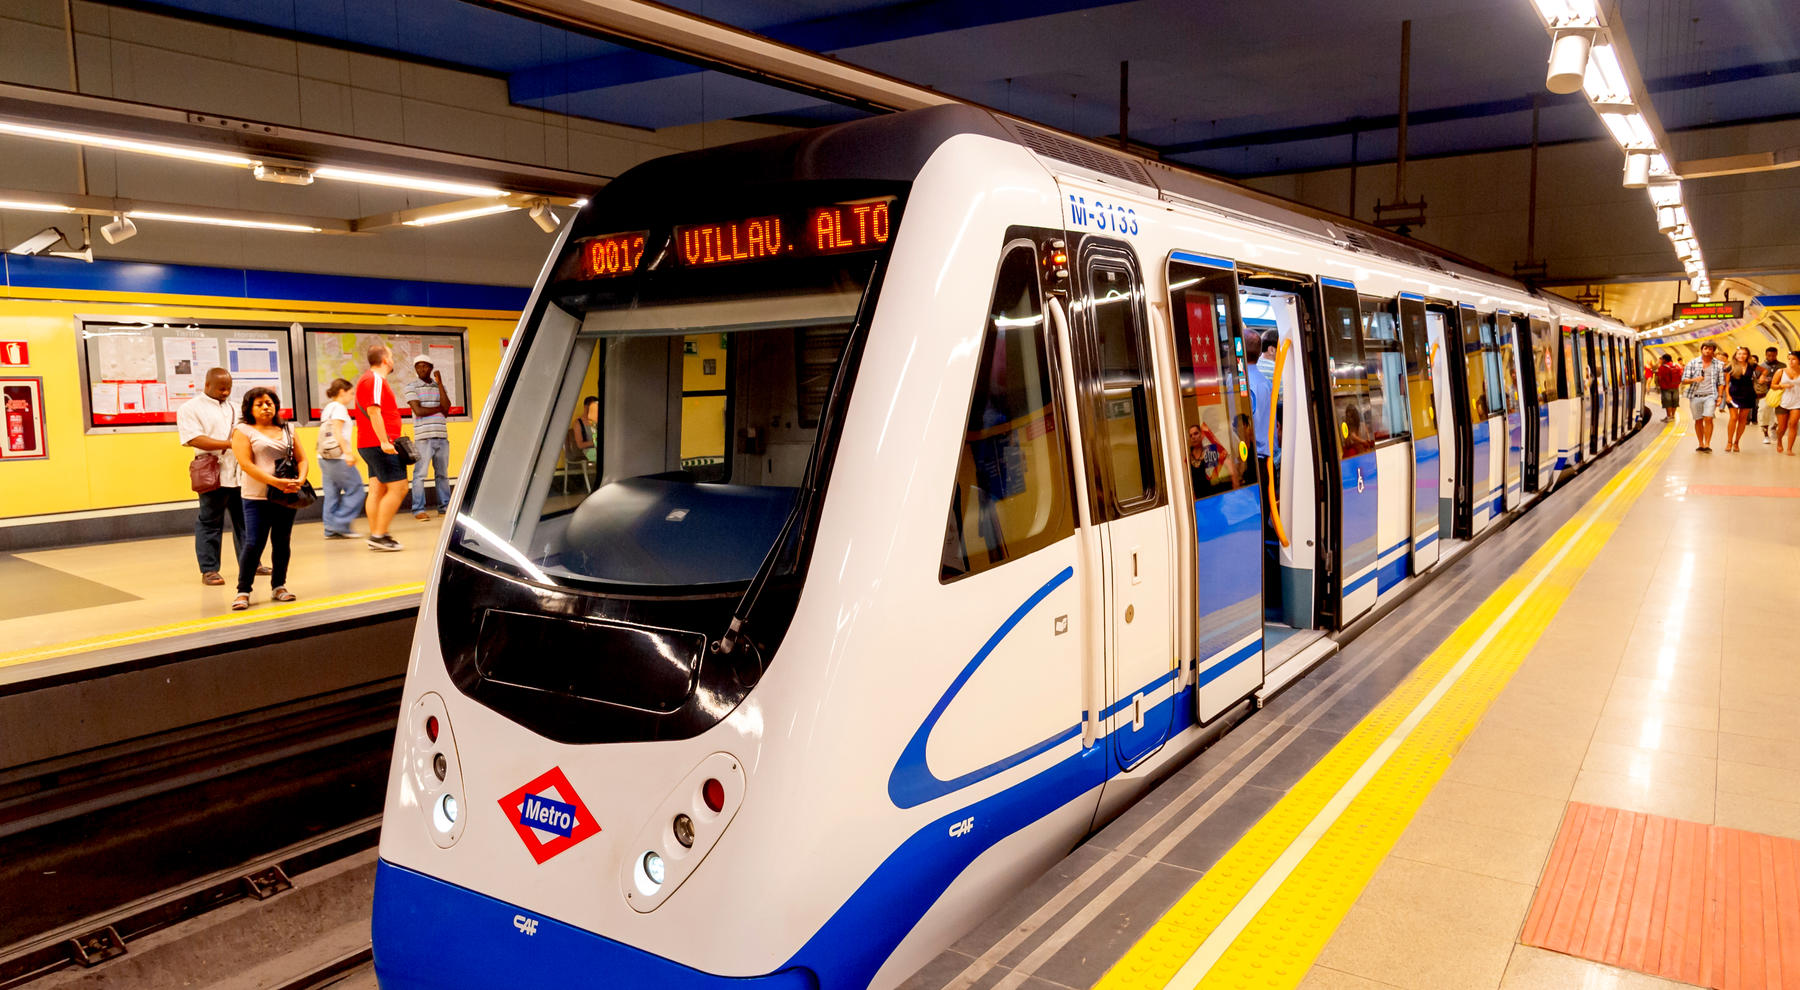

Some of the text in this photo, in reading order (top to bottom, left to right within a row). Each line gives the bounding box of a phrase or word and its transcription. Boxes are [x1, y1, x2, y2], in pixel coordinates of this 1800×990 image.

[1069, 194, 1138, 236] M-3133
[684, 204, 889, 264] VILLAV. ALTO
[525, 798, 571, 830] Metro
[948, 816, 975, 838] CAF
[513, 914, 539, 936] CAF
